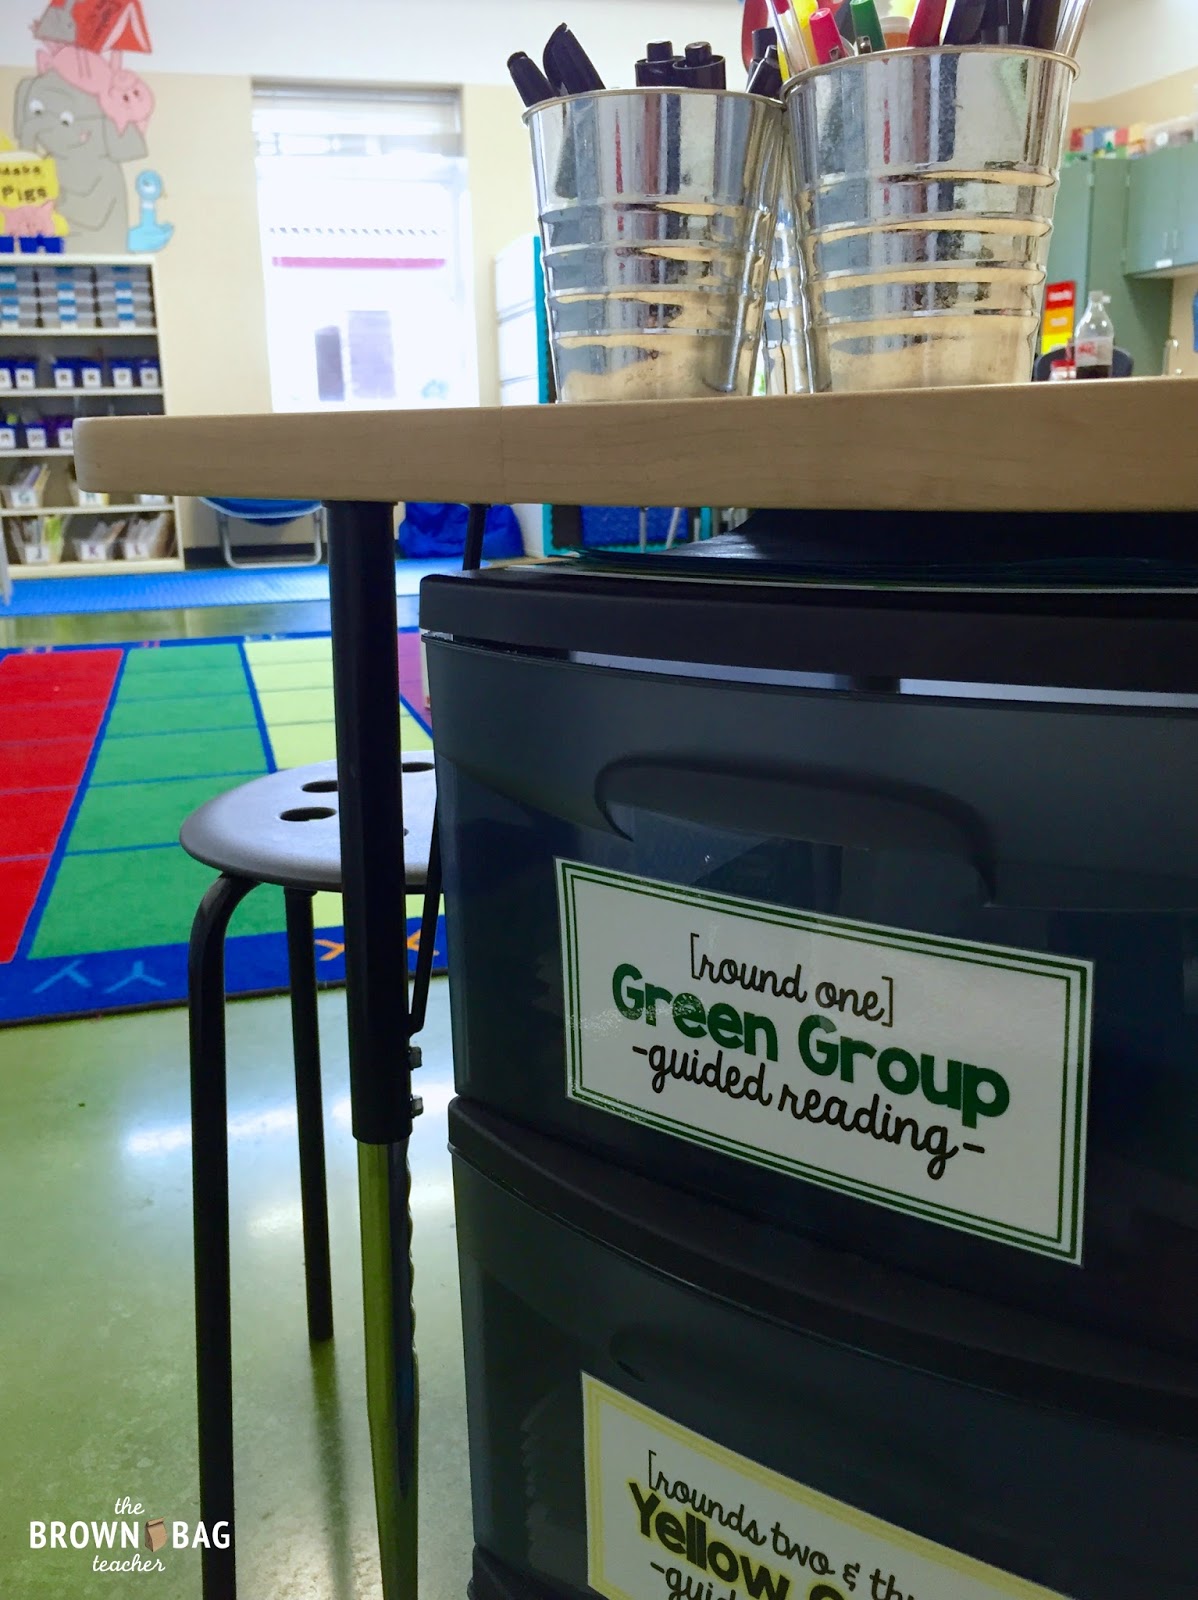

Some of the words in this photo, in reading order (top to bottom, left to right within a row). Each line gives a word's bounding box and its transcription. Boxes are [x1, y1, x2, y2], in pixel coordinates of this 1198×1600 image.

[612, 963, 778, 1062] Green
[798, 1015, 1010, 1128] Group
[629, 1482, 790, 1600] Yellow
[771, 1522, 835, 1575] two
[869, 1568, 915, 1600] th
